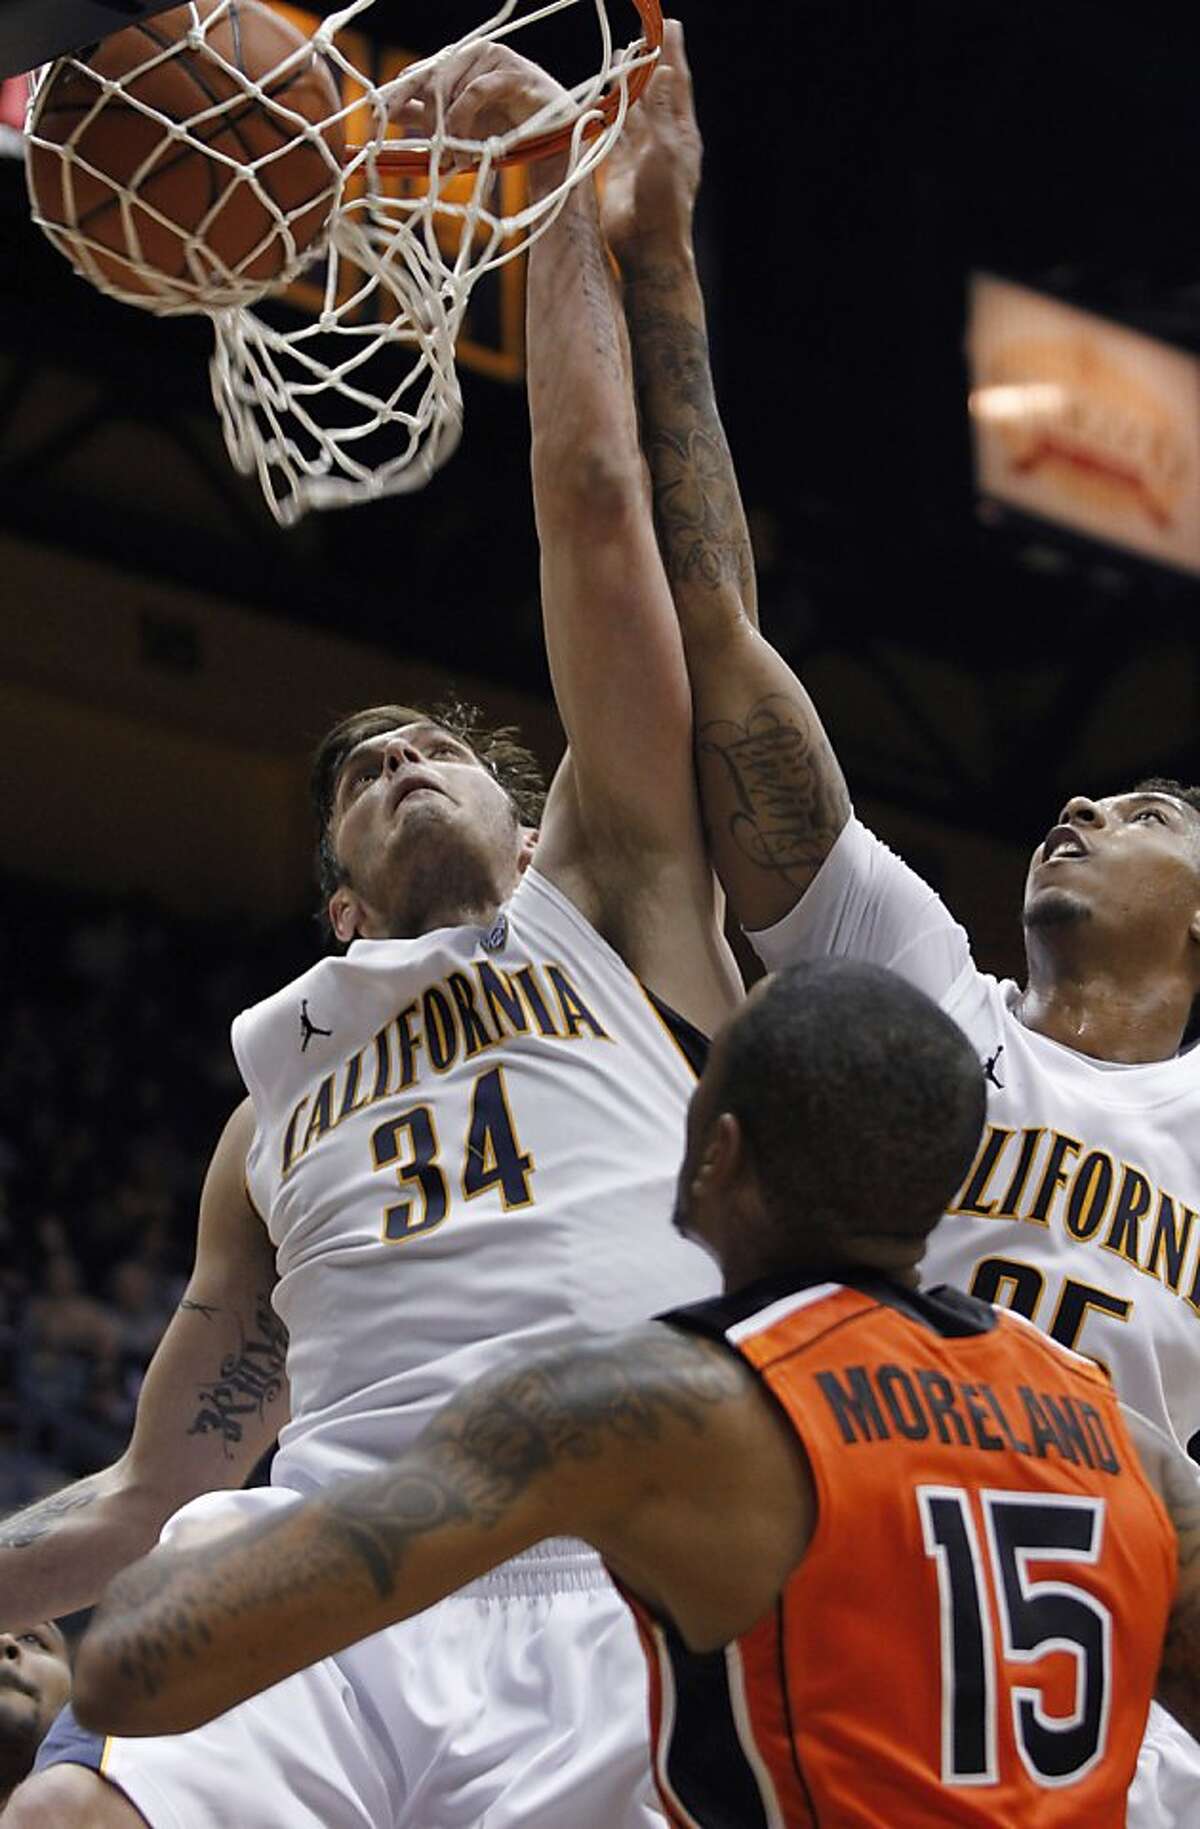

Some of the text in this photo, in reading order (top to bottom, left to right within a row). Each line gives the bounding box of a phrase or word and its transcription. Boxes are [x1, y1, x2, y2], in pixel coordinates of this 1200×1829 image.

[281, 959, 615, 1180] CALIFORNIA
[371, 1064, 536, 1246] 34
[945, 1123, 1200, 1318] LIFORN
[815, 1364, 1121, 1476] MORELAND
[916, 1485, 1112, 1789] 15
